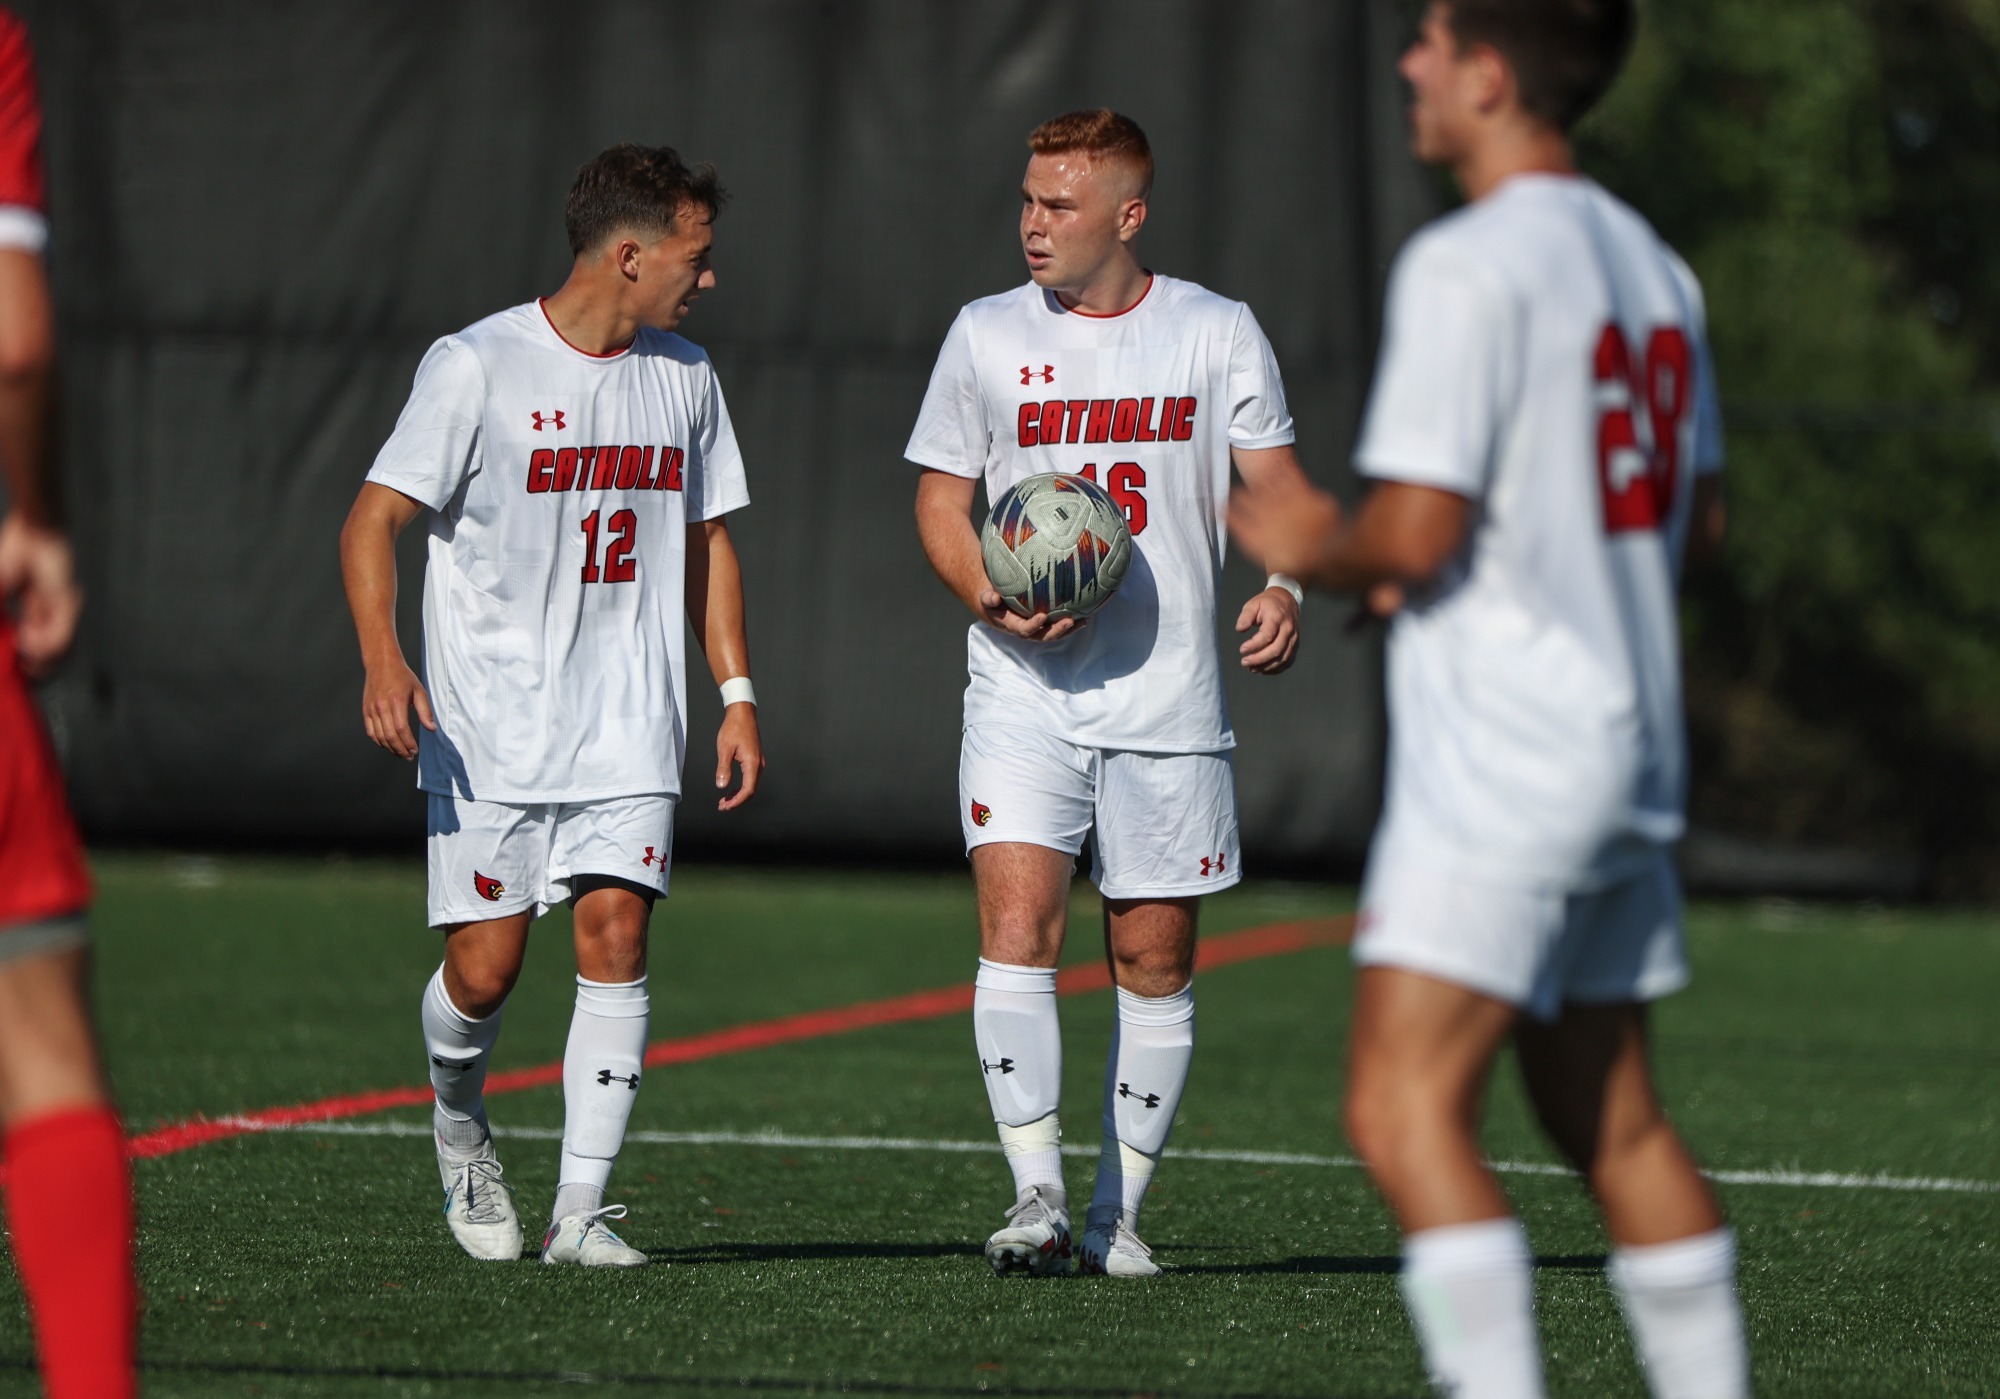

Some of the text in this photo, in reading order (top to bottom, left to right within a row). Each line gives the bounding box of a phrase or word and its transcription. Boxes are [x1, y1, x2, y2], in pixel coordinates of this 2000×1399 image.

[1017, 396, 1197, 448] CATHOLIC
[526, 445, 684, 494] CATHOLIC
[1075, 462, 1147, 536] 6
[580, 508, 637, 584] 12
